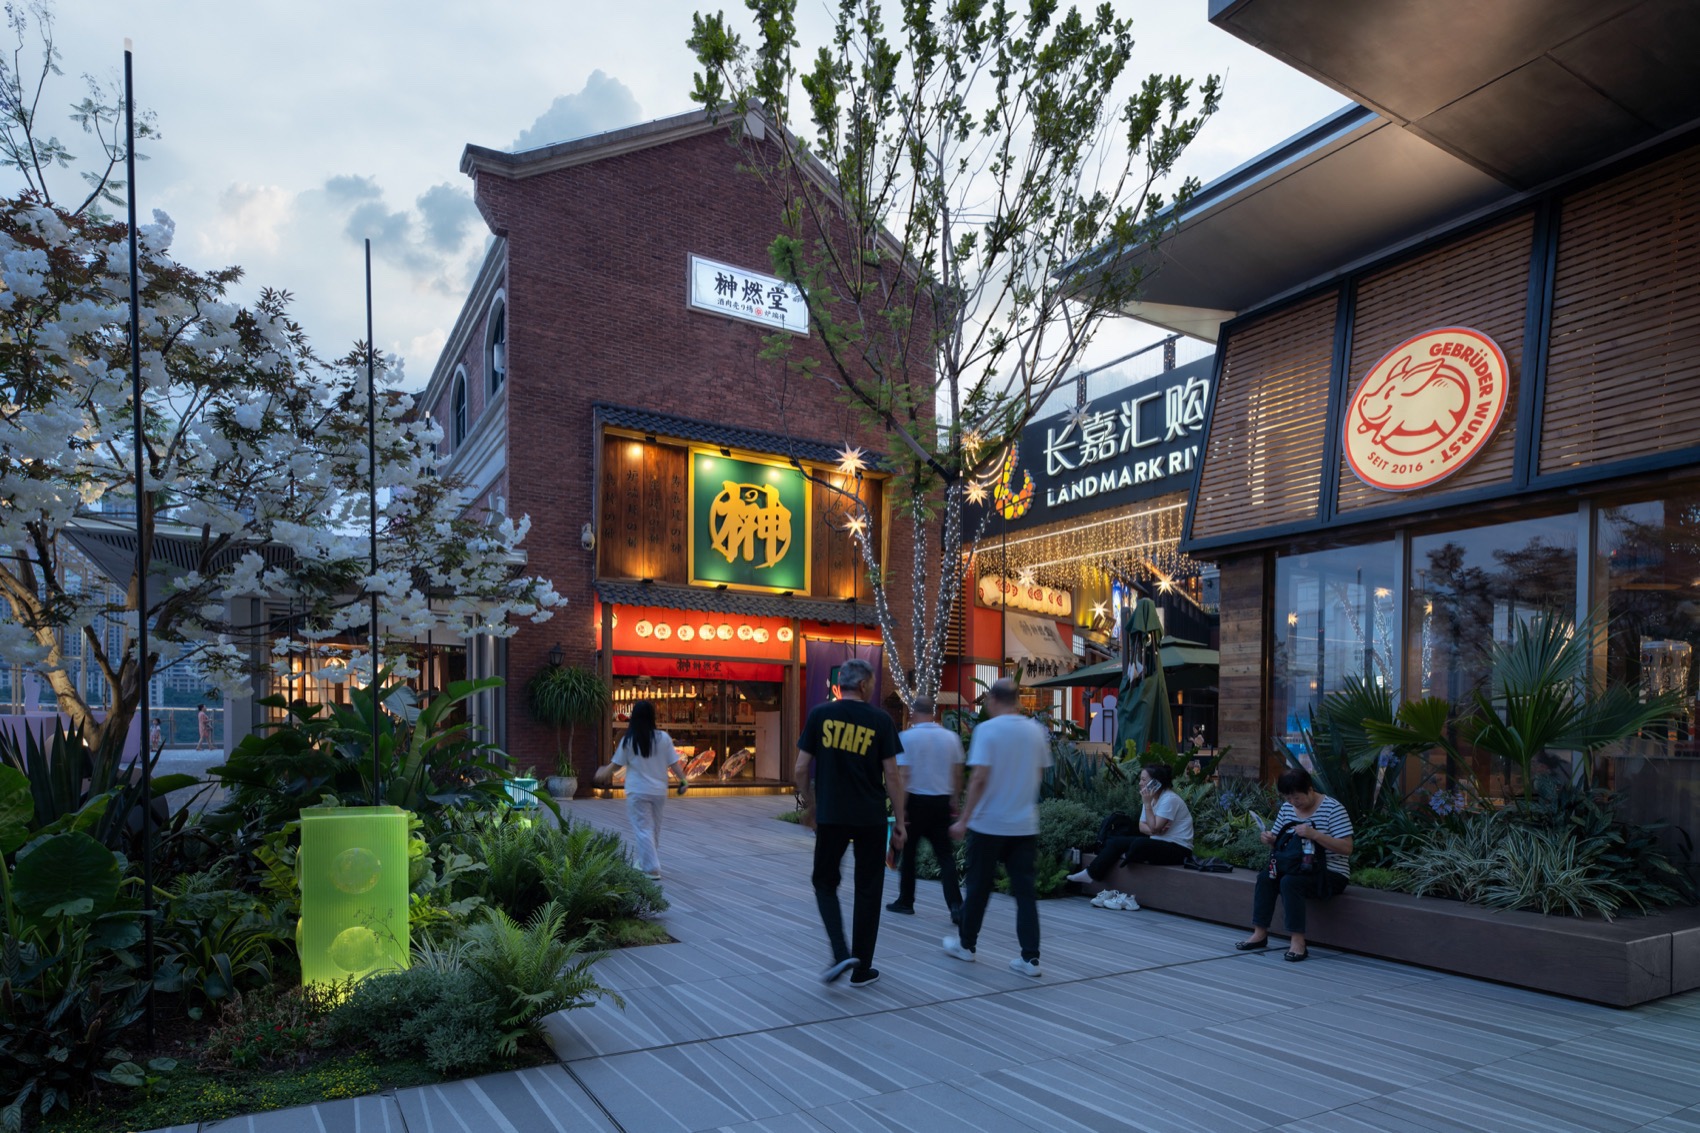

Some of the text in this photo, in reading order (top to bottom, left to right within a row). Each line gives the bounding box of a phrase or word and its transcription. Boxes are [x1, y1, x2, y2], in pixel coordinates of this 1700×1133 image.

[1043, 376, 1210, 476] 长嘉汇购
[1429, 341, 1494, 464] GEBRÜDER WURST
[1046, 454, 1166, 507] LANDMARK
[1367, 451, 1424, 474] SEIT 2016
[821, 718, 876, 757] STAFF
